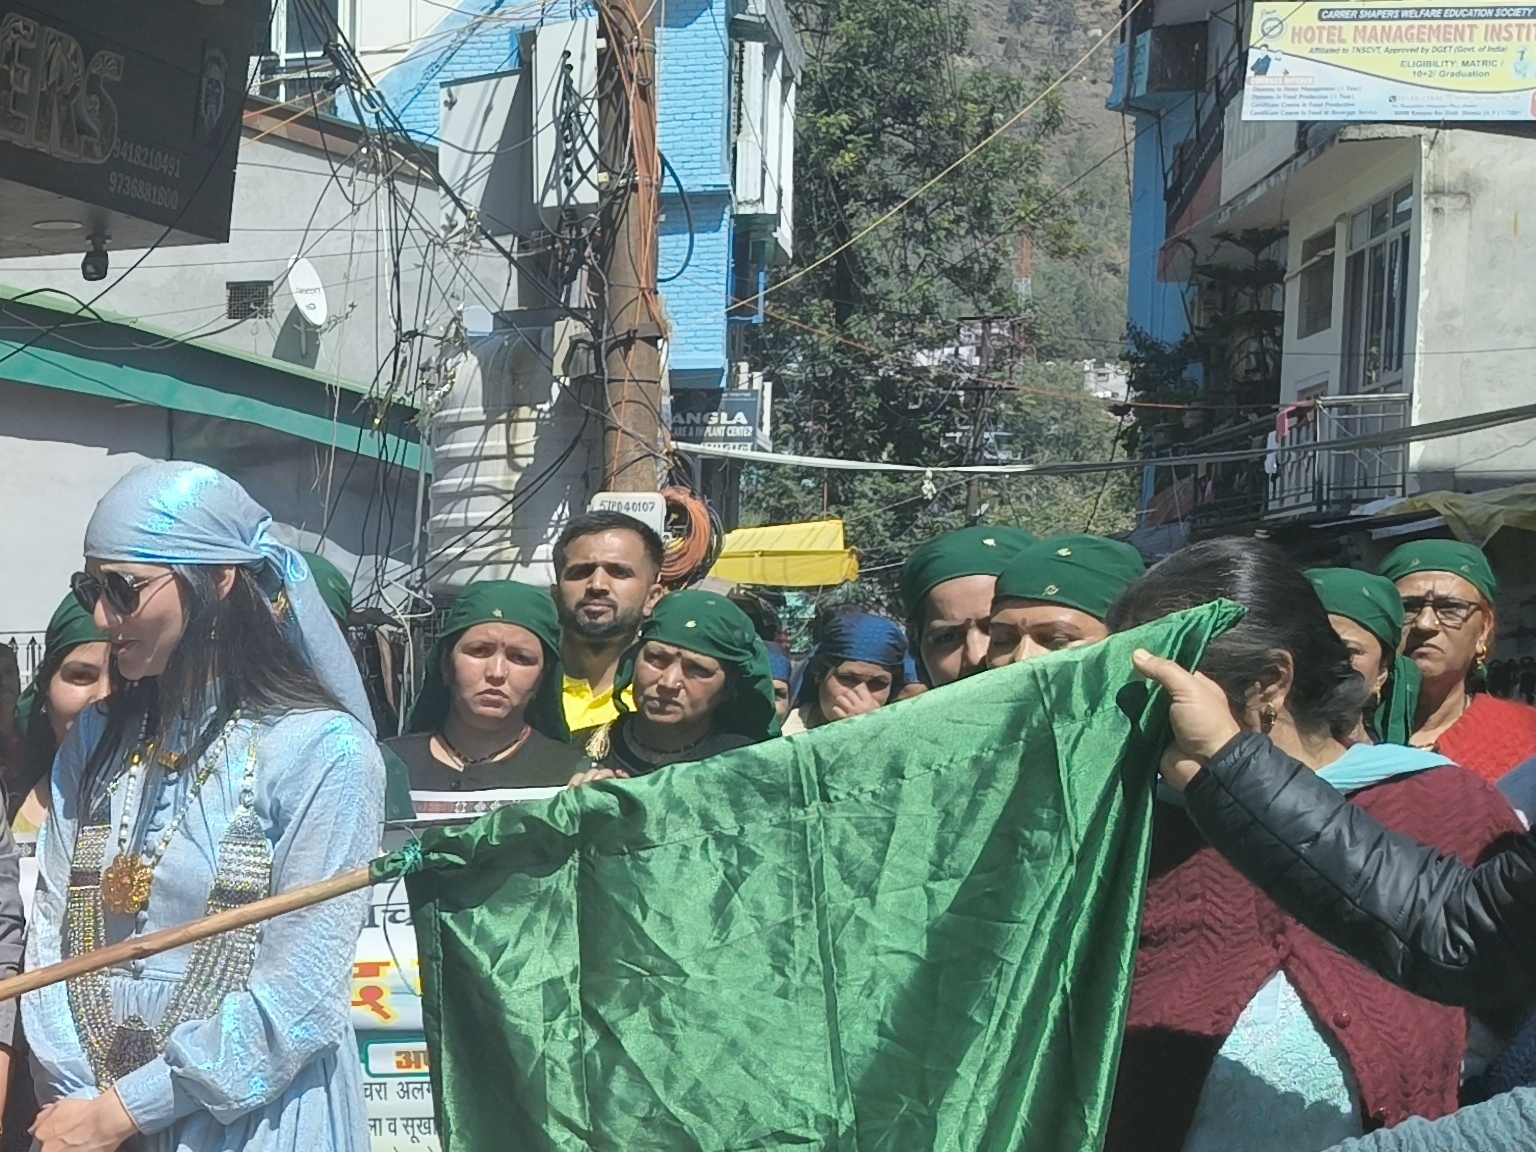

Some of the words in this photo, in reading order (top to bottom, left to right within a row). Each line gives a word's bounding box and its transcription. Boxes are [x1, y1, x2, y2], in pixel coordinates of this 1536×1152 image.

[1359, 9, 1400, 19] SHAPERS
[1401, 9, 1442, 18] WELFARE
[1443, 8, 1494, 18] EDUCATION
[1495, 7, 1533, 17] SOCIETY
[1291, 25, 1347, 44] HOTEL
[1353, 24, 1478, 44] MANAGEMENT
[1383, 46, 1419, 55] Approved
[1420, 46, 1430, 55] by
[672, 411, 748, 425] ANGLA
[363, 1083, 387, 1101] चरा
